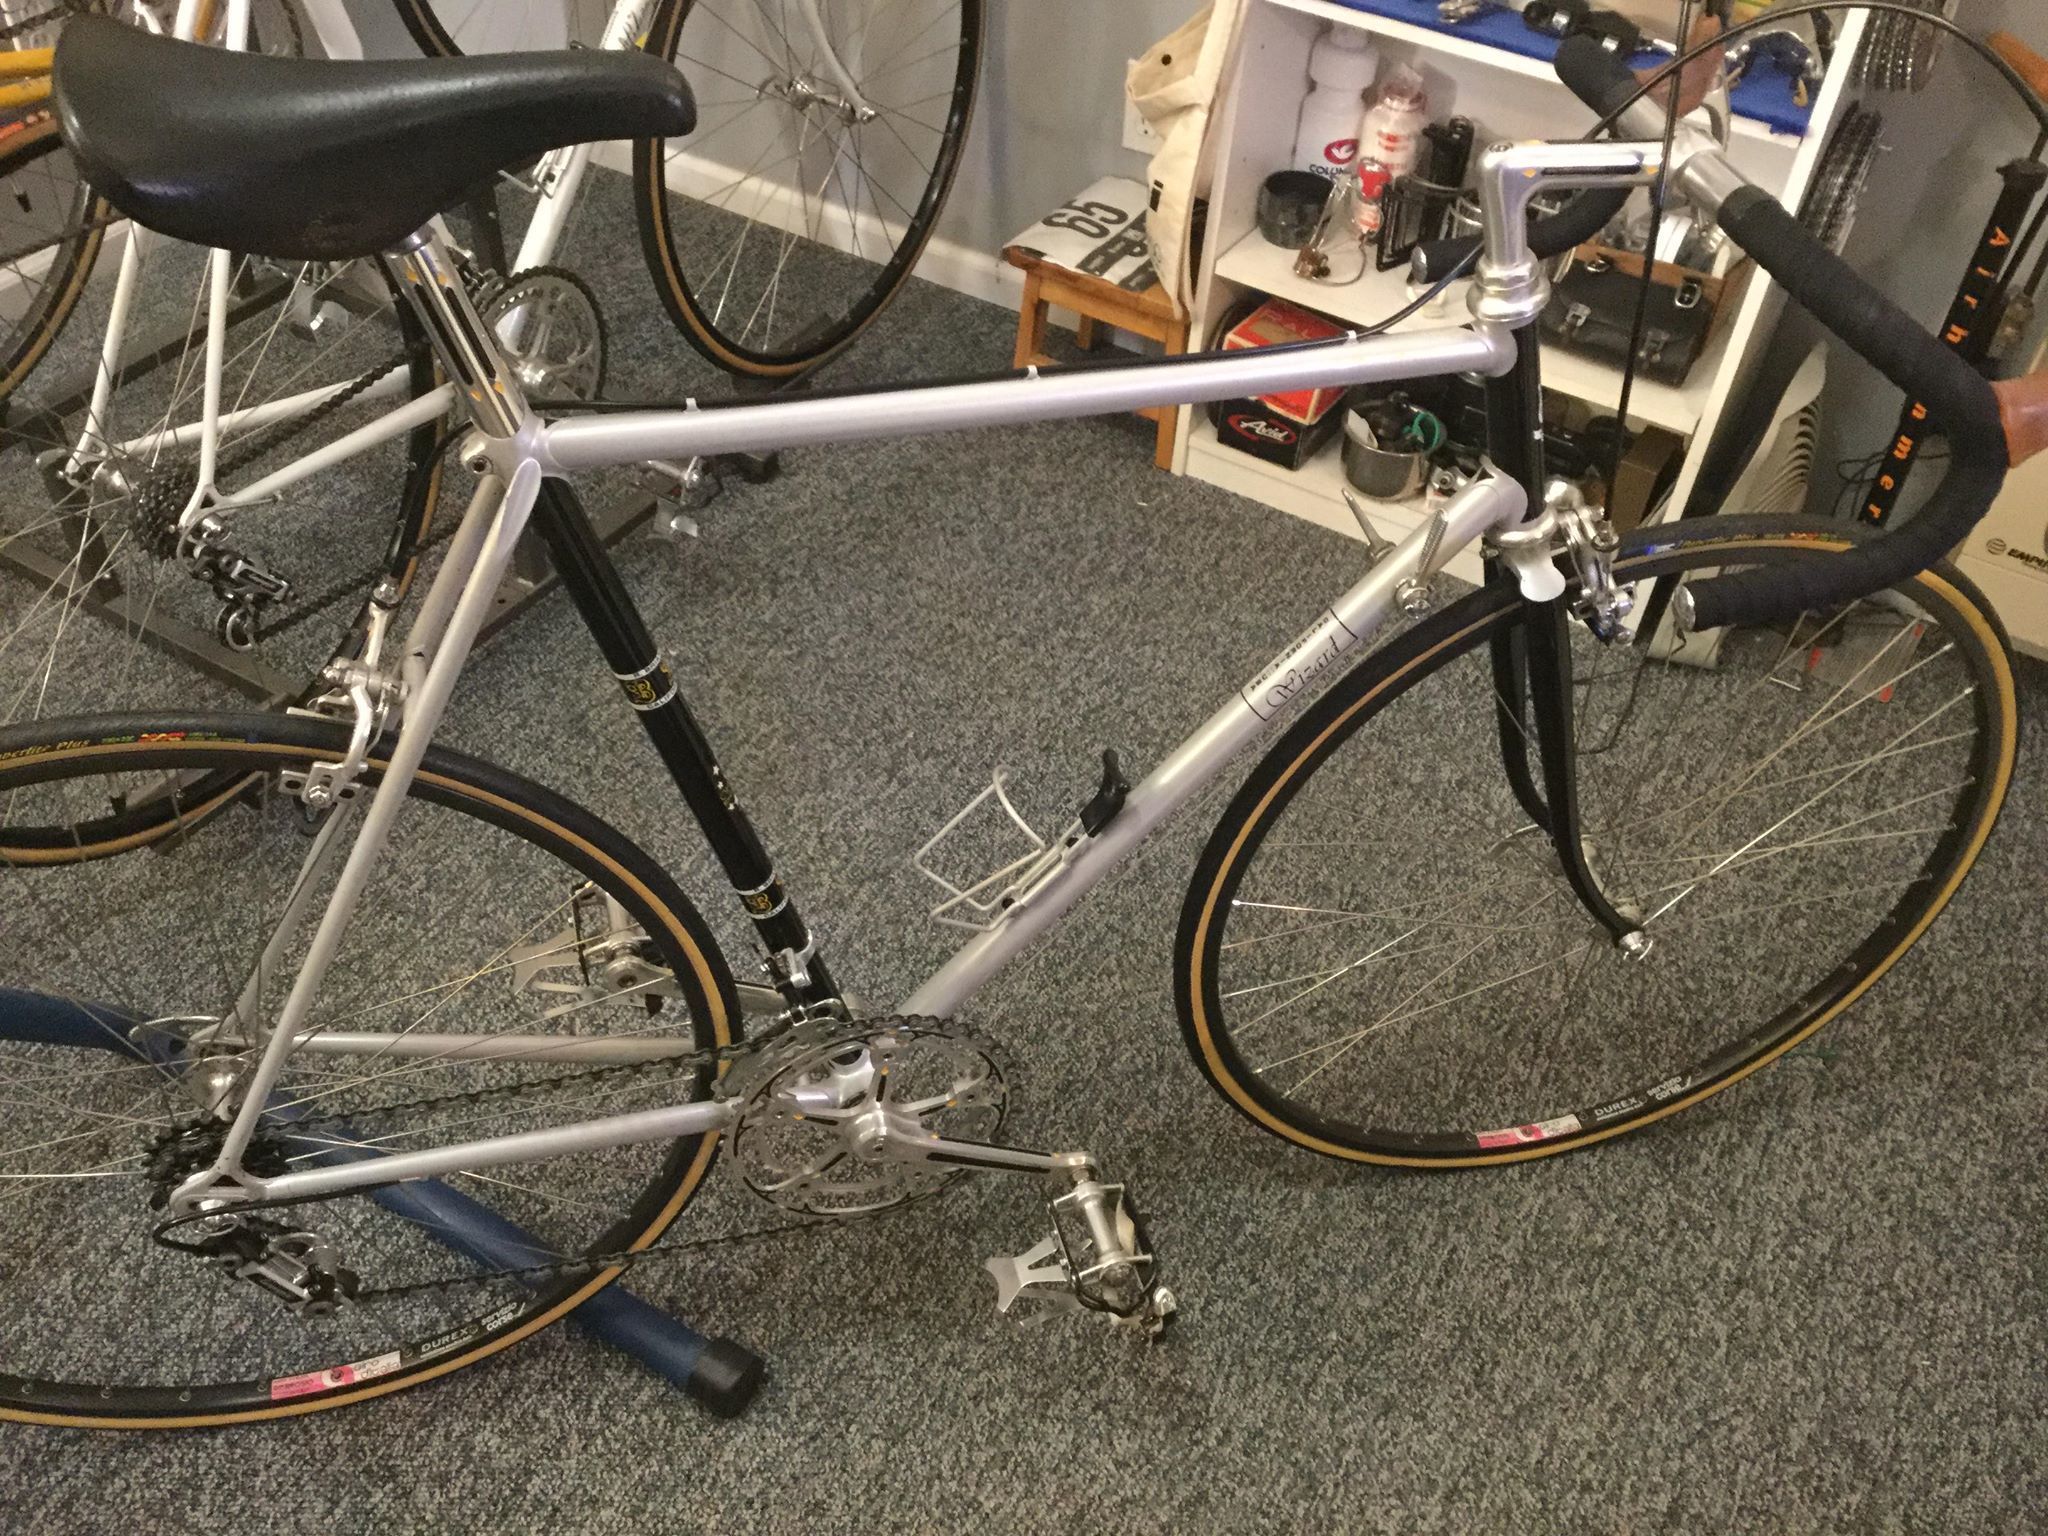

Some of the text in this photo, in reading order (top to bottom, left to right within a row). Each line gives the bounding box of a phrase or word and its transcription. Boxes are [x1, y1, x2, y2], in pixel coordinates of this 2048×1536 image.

[1239, 419, 1289, 442] Avid
[1265, 634, 1341, 708] Wizard
[1593, 1096, 1639, 1117] DUREX
[420, 1326, 469, 1353] DUREX
